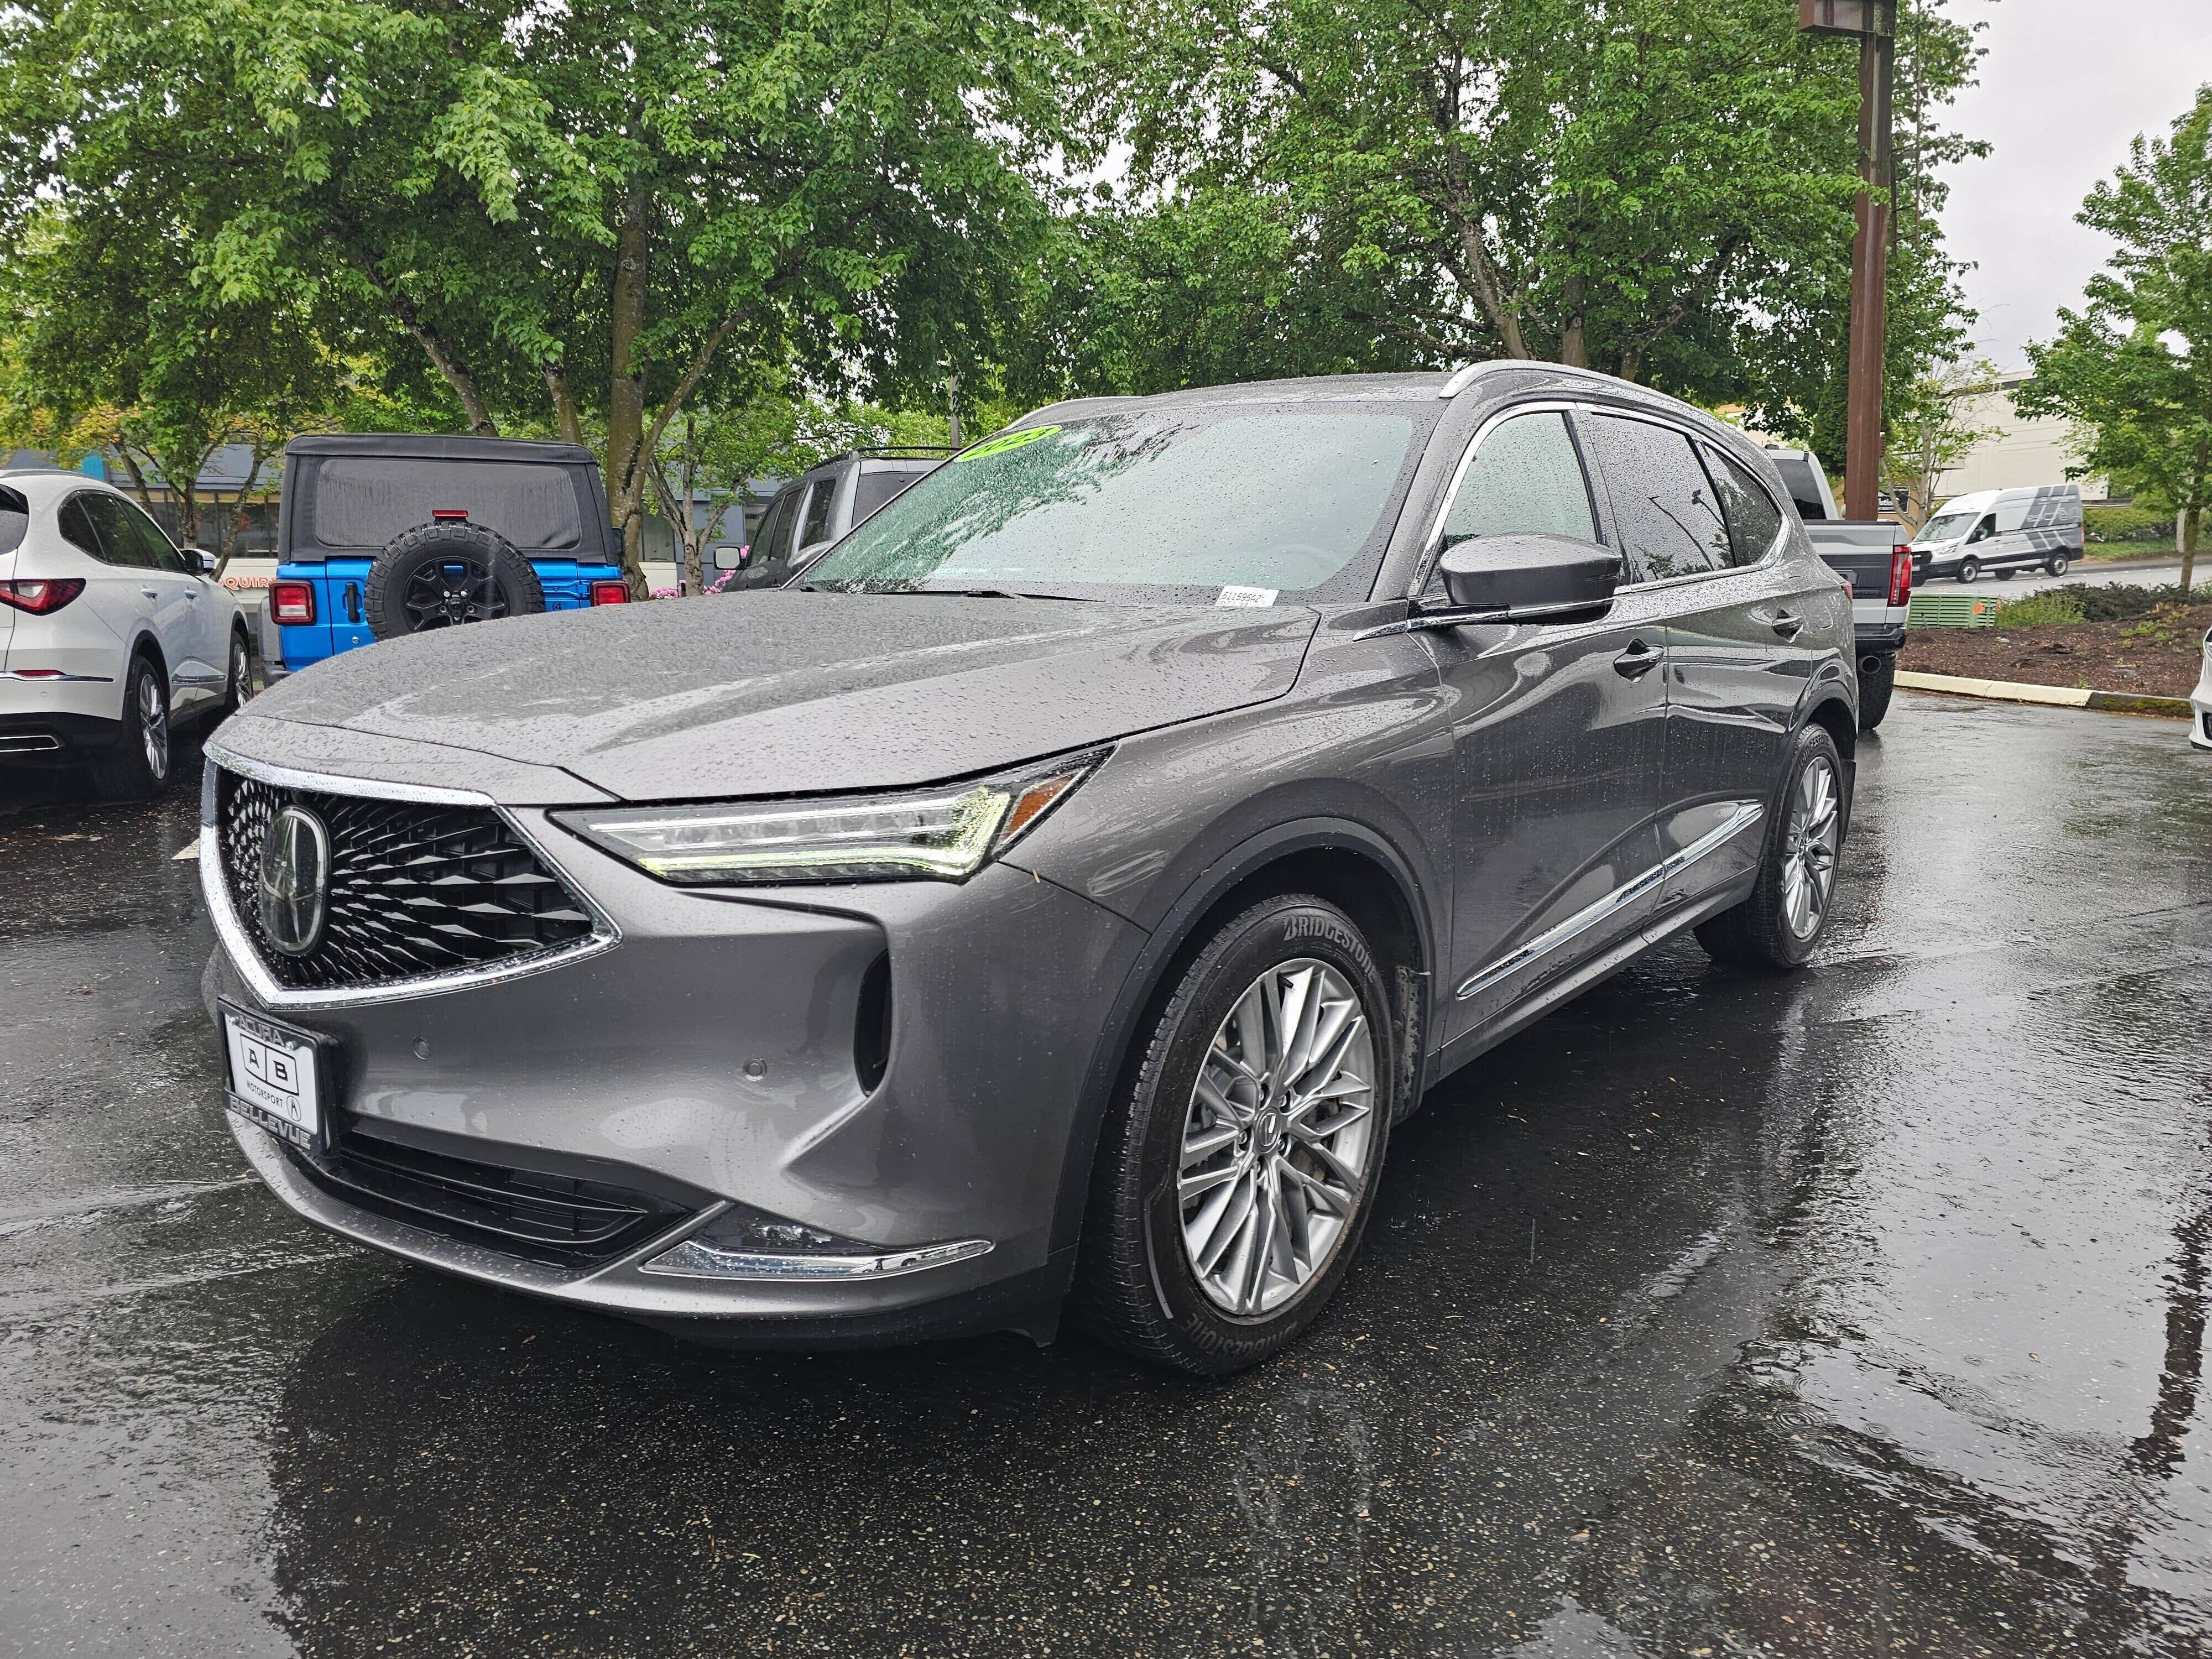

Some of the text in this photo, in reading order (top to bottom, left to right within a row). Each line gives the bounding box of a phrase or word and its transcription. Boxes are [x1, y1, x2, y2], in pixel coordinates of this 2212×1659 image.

[218, 576, 276, 590] QUIR
[1283, 915, 1379, 984] BRIDGESTONE
[239, 1015, 285, 1047] ACURA
[248, 1047, 288, 1082] A B
[247, 1079, 283, 1108] MOTORSPORT
[229, 1094, 311, 1150] BELLEVUE
